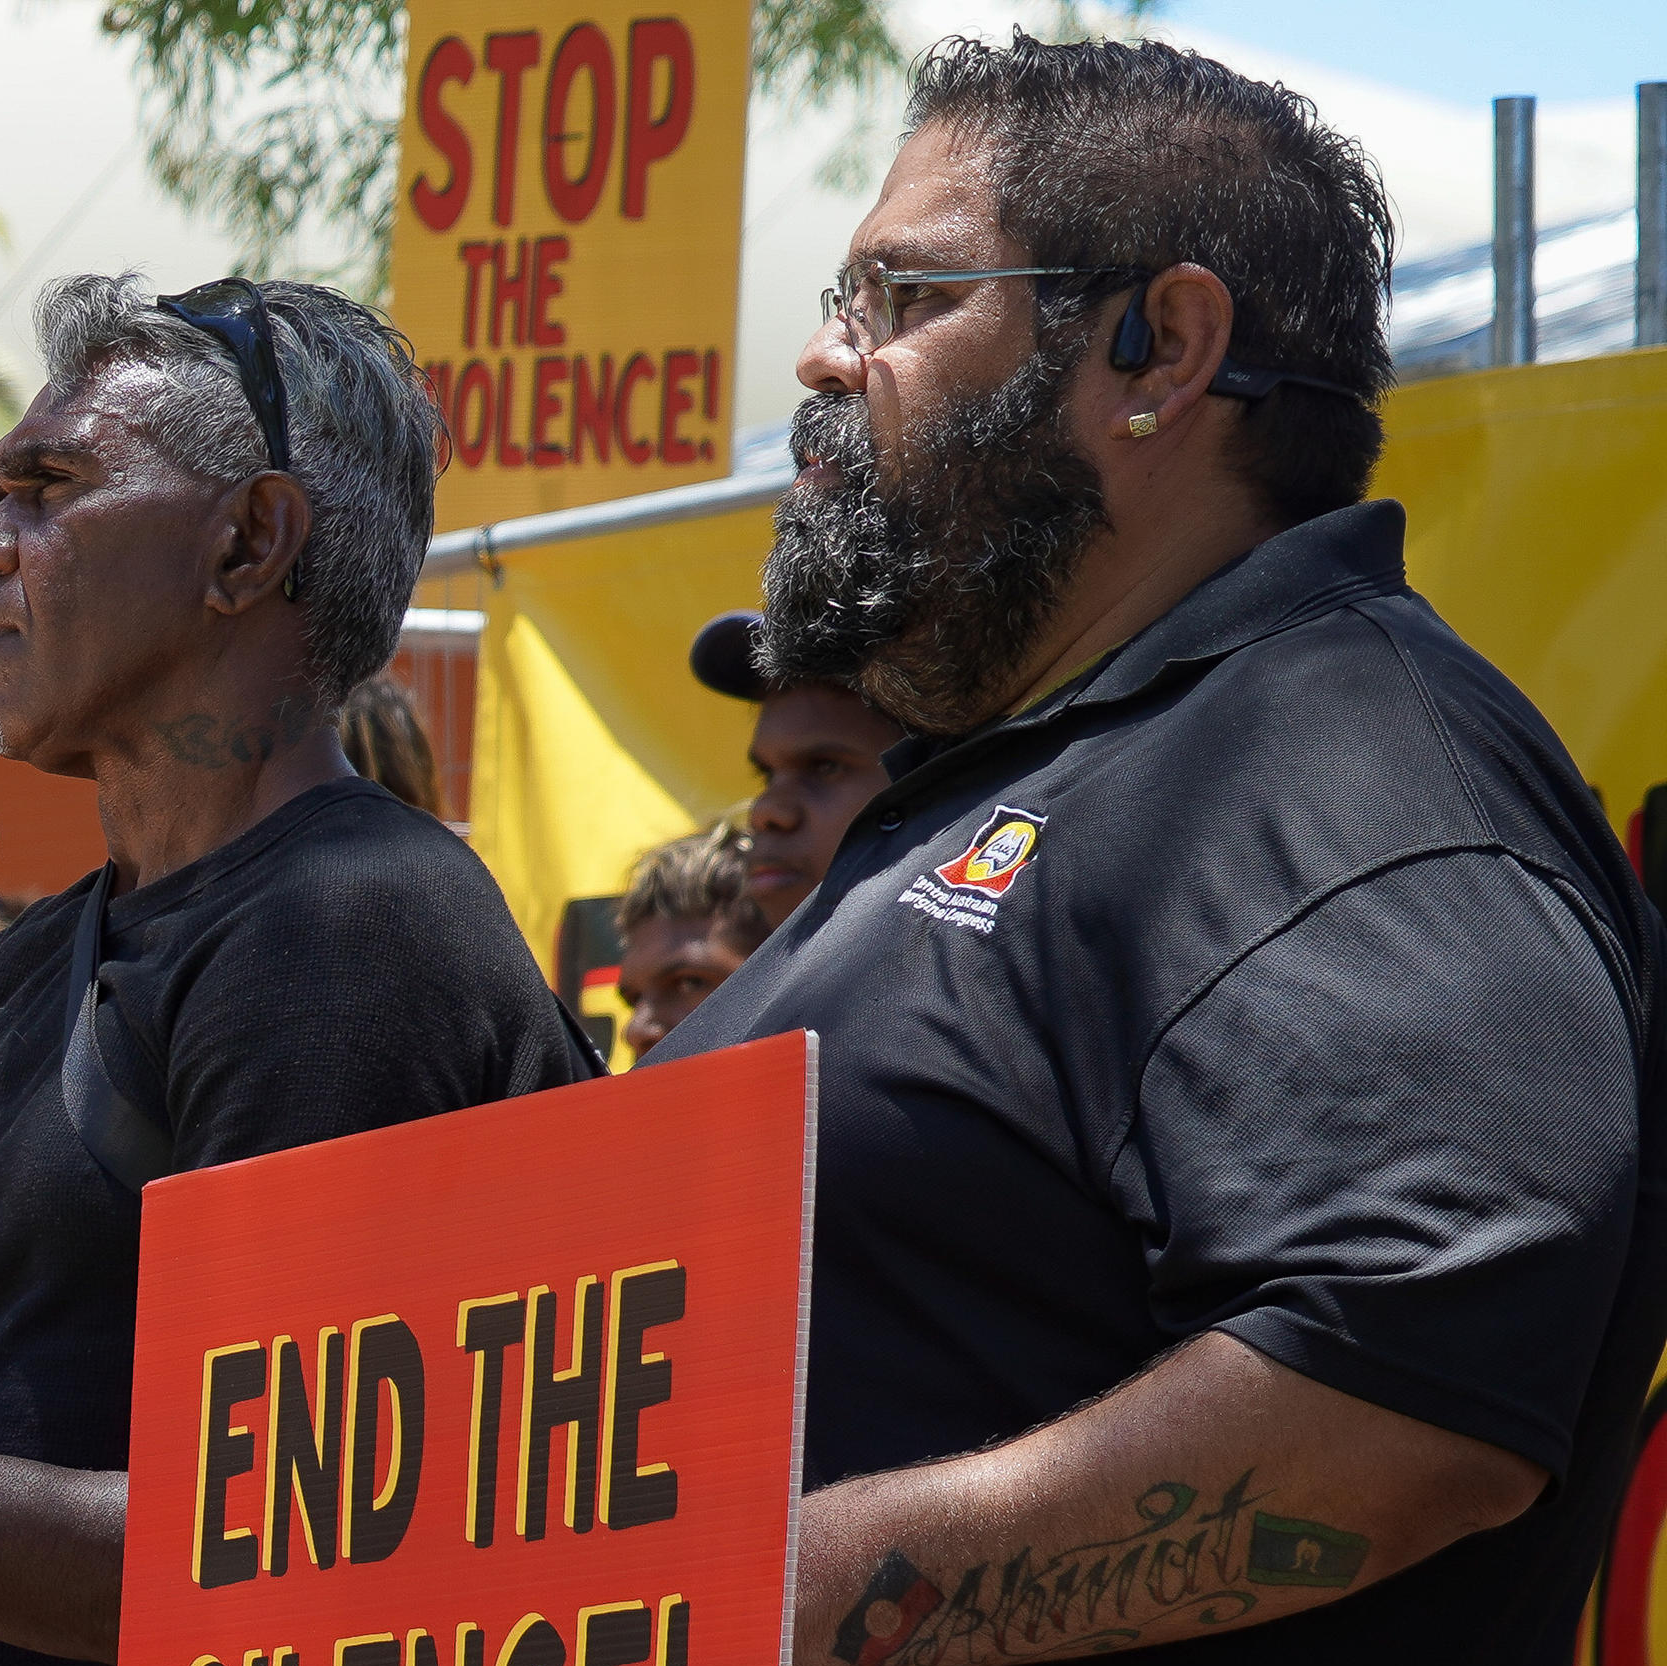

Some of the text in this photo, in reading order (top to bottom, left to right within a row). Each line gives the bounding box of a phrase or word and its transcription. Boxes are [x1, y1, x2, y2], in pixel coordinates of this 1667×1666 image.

[409, 18, 695, 233] STOP
[460, 237, 569, 350] THE
[191, 1259, 686, 1590] END THE
